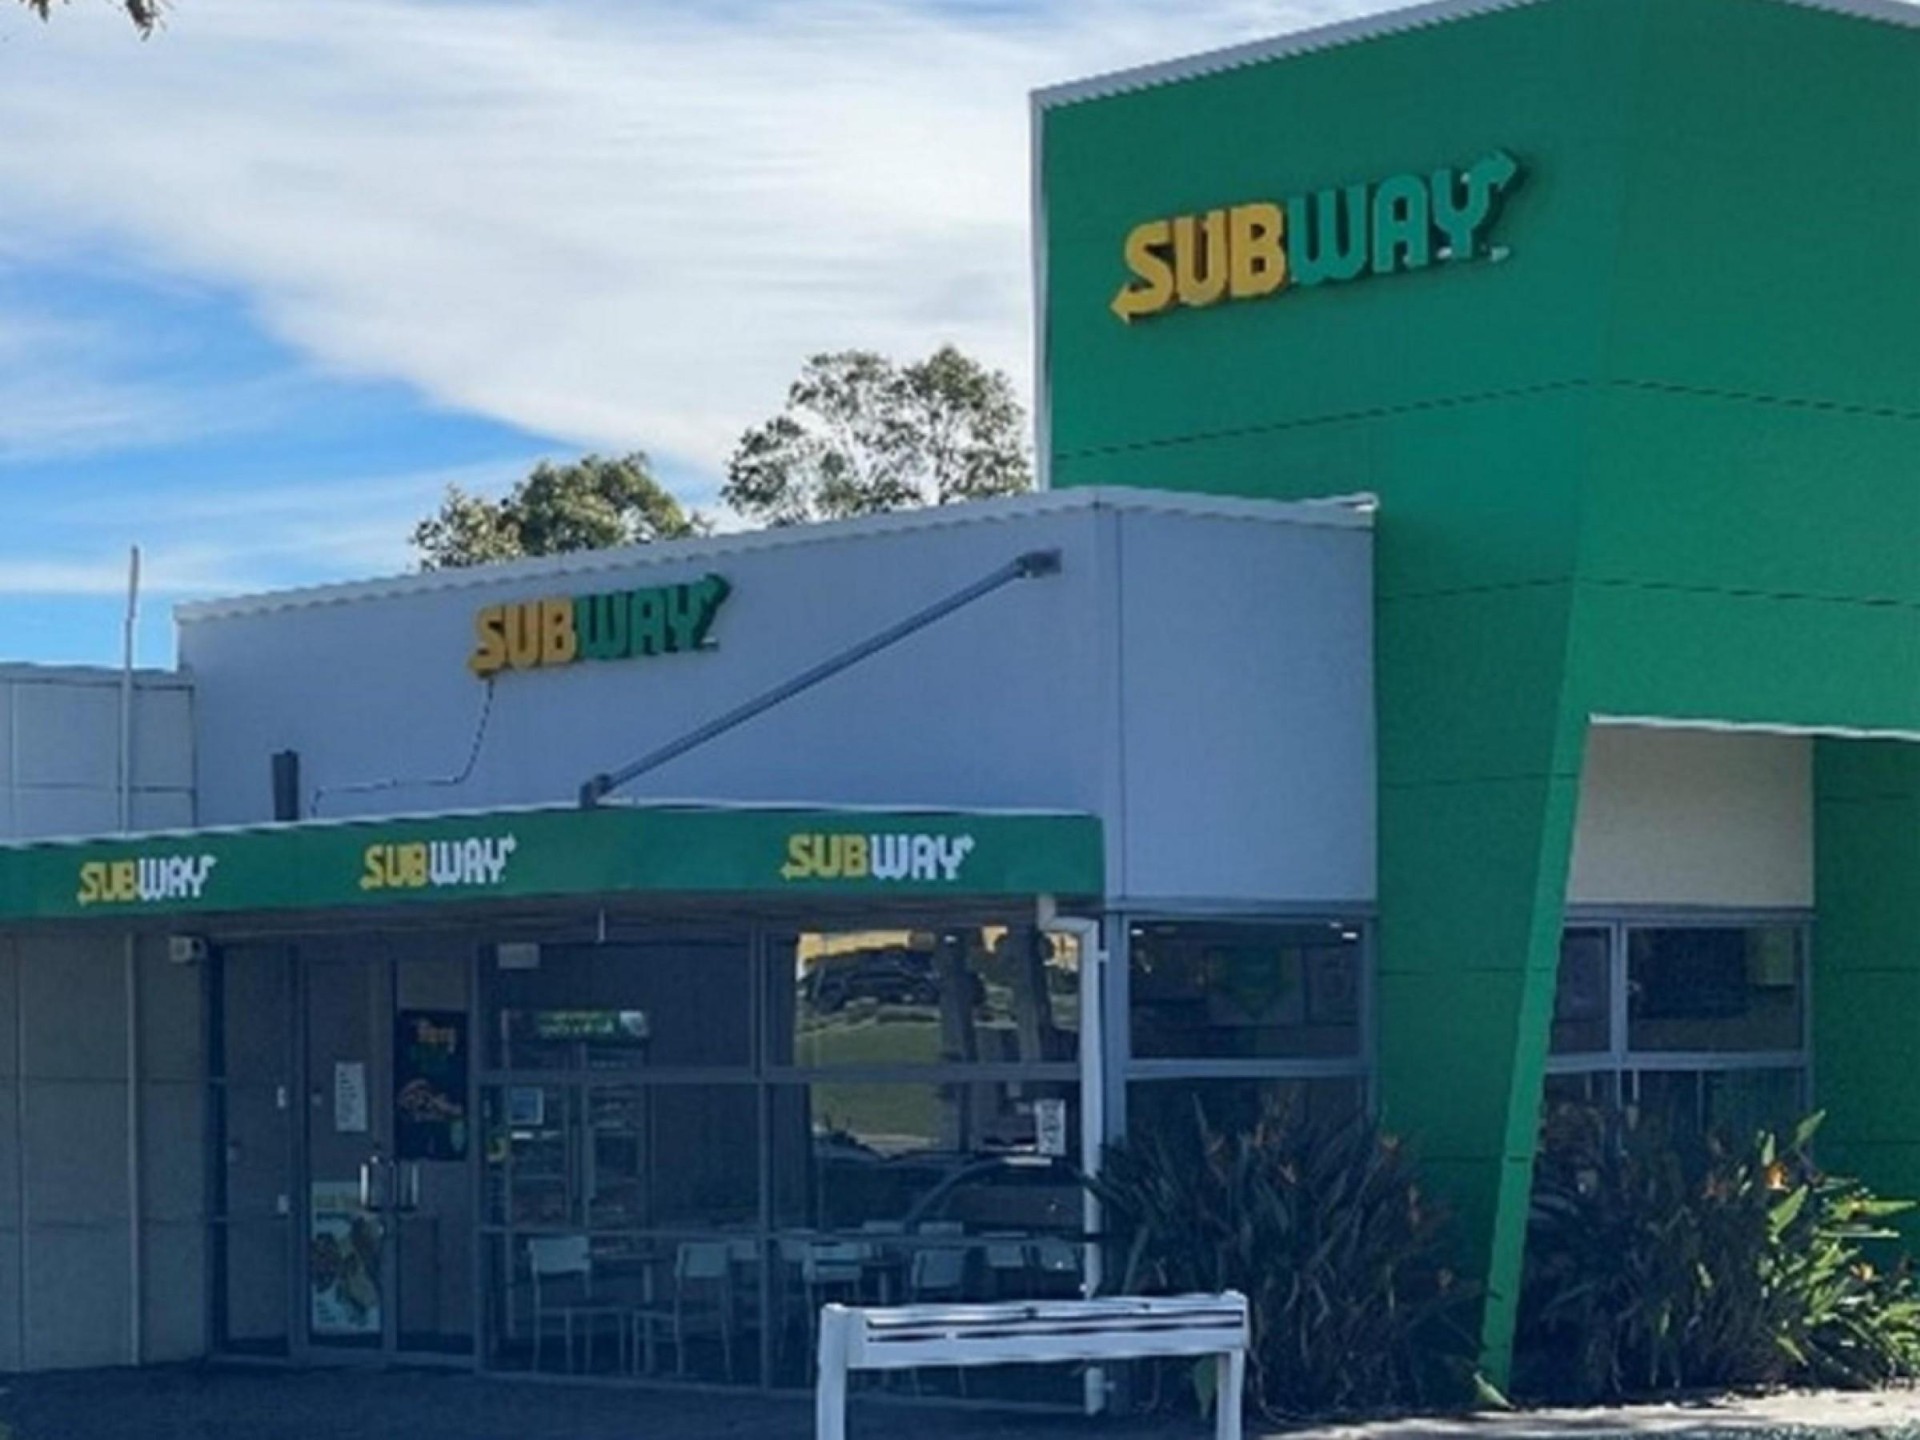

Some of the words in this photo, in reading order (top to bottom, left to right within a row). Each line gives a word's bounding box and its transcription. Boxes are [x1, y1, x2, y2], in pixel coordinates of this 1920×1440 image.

[1110, 151, 1517, 324] SUBWAY
[470, 573, 730, 677] SUBWAY
[77, 855, 217, 906] SUBWAY
[360, 834, 516, 890] SUBWAY
[780, 833, 975, 880] SUBWAY
